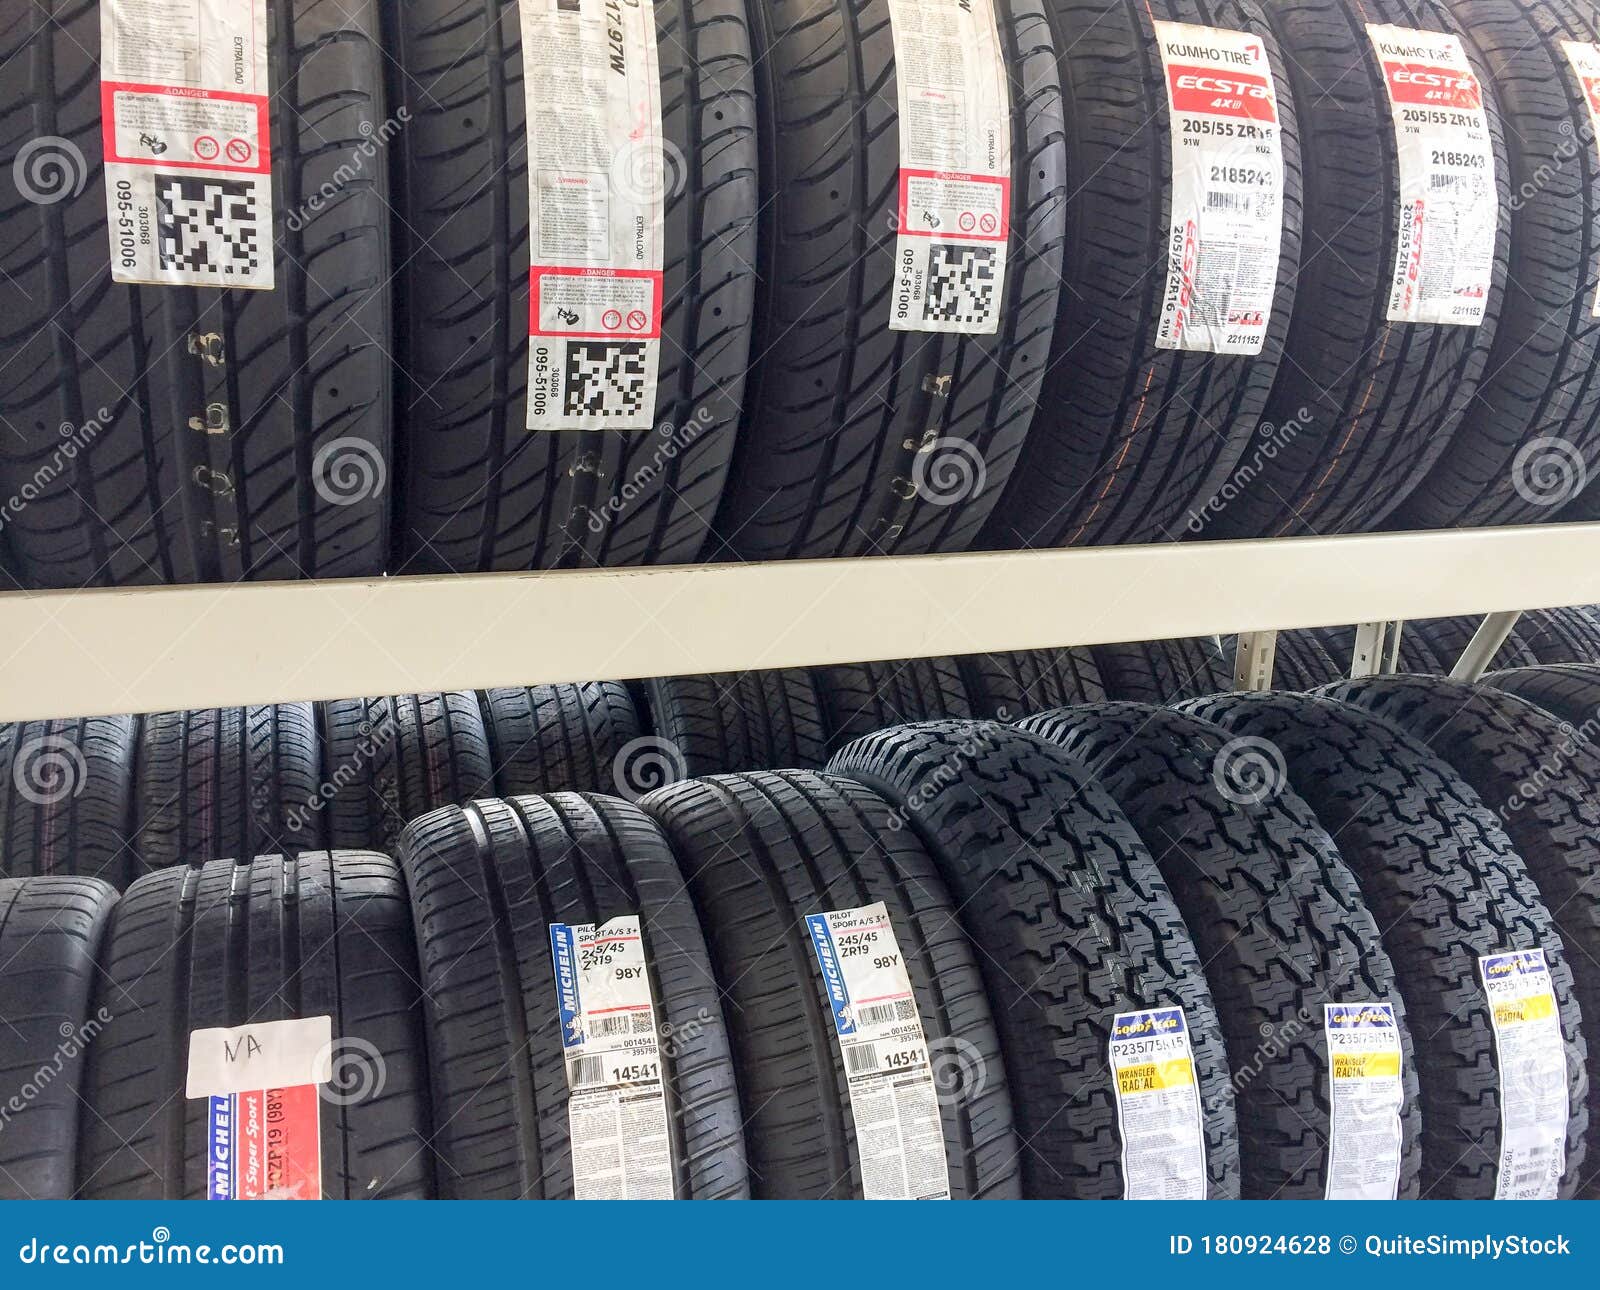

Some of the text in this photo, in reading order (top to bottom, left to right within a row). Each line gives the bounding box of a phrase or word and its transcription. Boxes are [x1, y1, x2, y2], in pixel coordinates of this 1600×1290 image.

[233, 36, 244, 85] EXTRA LOAD
[608, 29, 625, 76] 97W
[1166, 43, 1252, 65] KUMHO TIRE
[171, 88, 209, 98] DANGER
[1182, 119, 1234, 136] 205/55
[1402, 110, 1481, 129] 205/55 ZR16
[987, 129, 995, 150] EXTRA
[1405, 126, 1420, 134] 91W
[1183, 138, 1200, 147] 91W
[1431, 151, 1485, 168] 2185243
[117, 180, 137, 268] 095-51006
[138, 206, 151, 245] 303068
[636, 216, 644, 260] EXTRA LOAD
[1391, 204, 1413, 311] 205/55 ZR16 91W
[586, 269, 616, 277] DANGER
[898, 249, 914, 319] 095-51006
[913, 269, 923, 300] 303068
[1451, 306, 1481, 316] 2211152
[1161, 318, 1171, 338] 91W
[1226, 334, 1260, 345] 2211152
[534, 347, 548, 415] 095-51006
[551, 367, 560, 398] 303068
[829, 911, 852, 921] PILOT
[832, 919, 858, 929] SPORT
[859, 917, 874, 926] A/S
[579, 929, 606, 942] SPORT
[607, 927, 624, 937] A/S
[838, 932, 878, 947] 245/45
[841, 945, 869, 958] ZR19
[556, 931, 576, 1011] MICHELIN
[812, 922, 845, 1002] MICHELIN
[873, 955, 899, 969] 98Y
[615, 966, 642, 980] 98Y
[891, 1024, 920, 1035] 0014541
[900, 1033, 923, 1043] 395798
[224, 1034, 262, 1064] NA
[624, 1037, 656, 1048] 0014541
[632, 1047, 657, 1057] 395798
[885, 1048, 926, 1068] 14541
[613, 1063, 658, 1082] 14541
[1119, 1067, 1155, 1080] WRANGLER
[246, 1096, 262, 1138] Sport
[247, 1141, 262, 1184] Super
